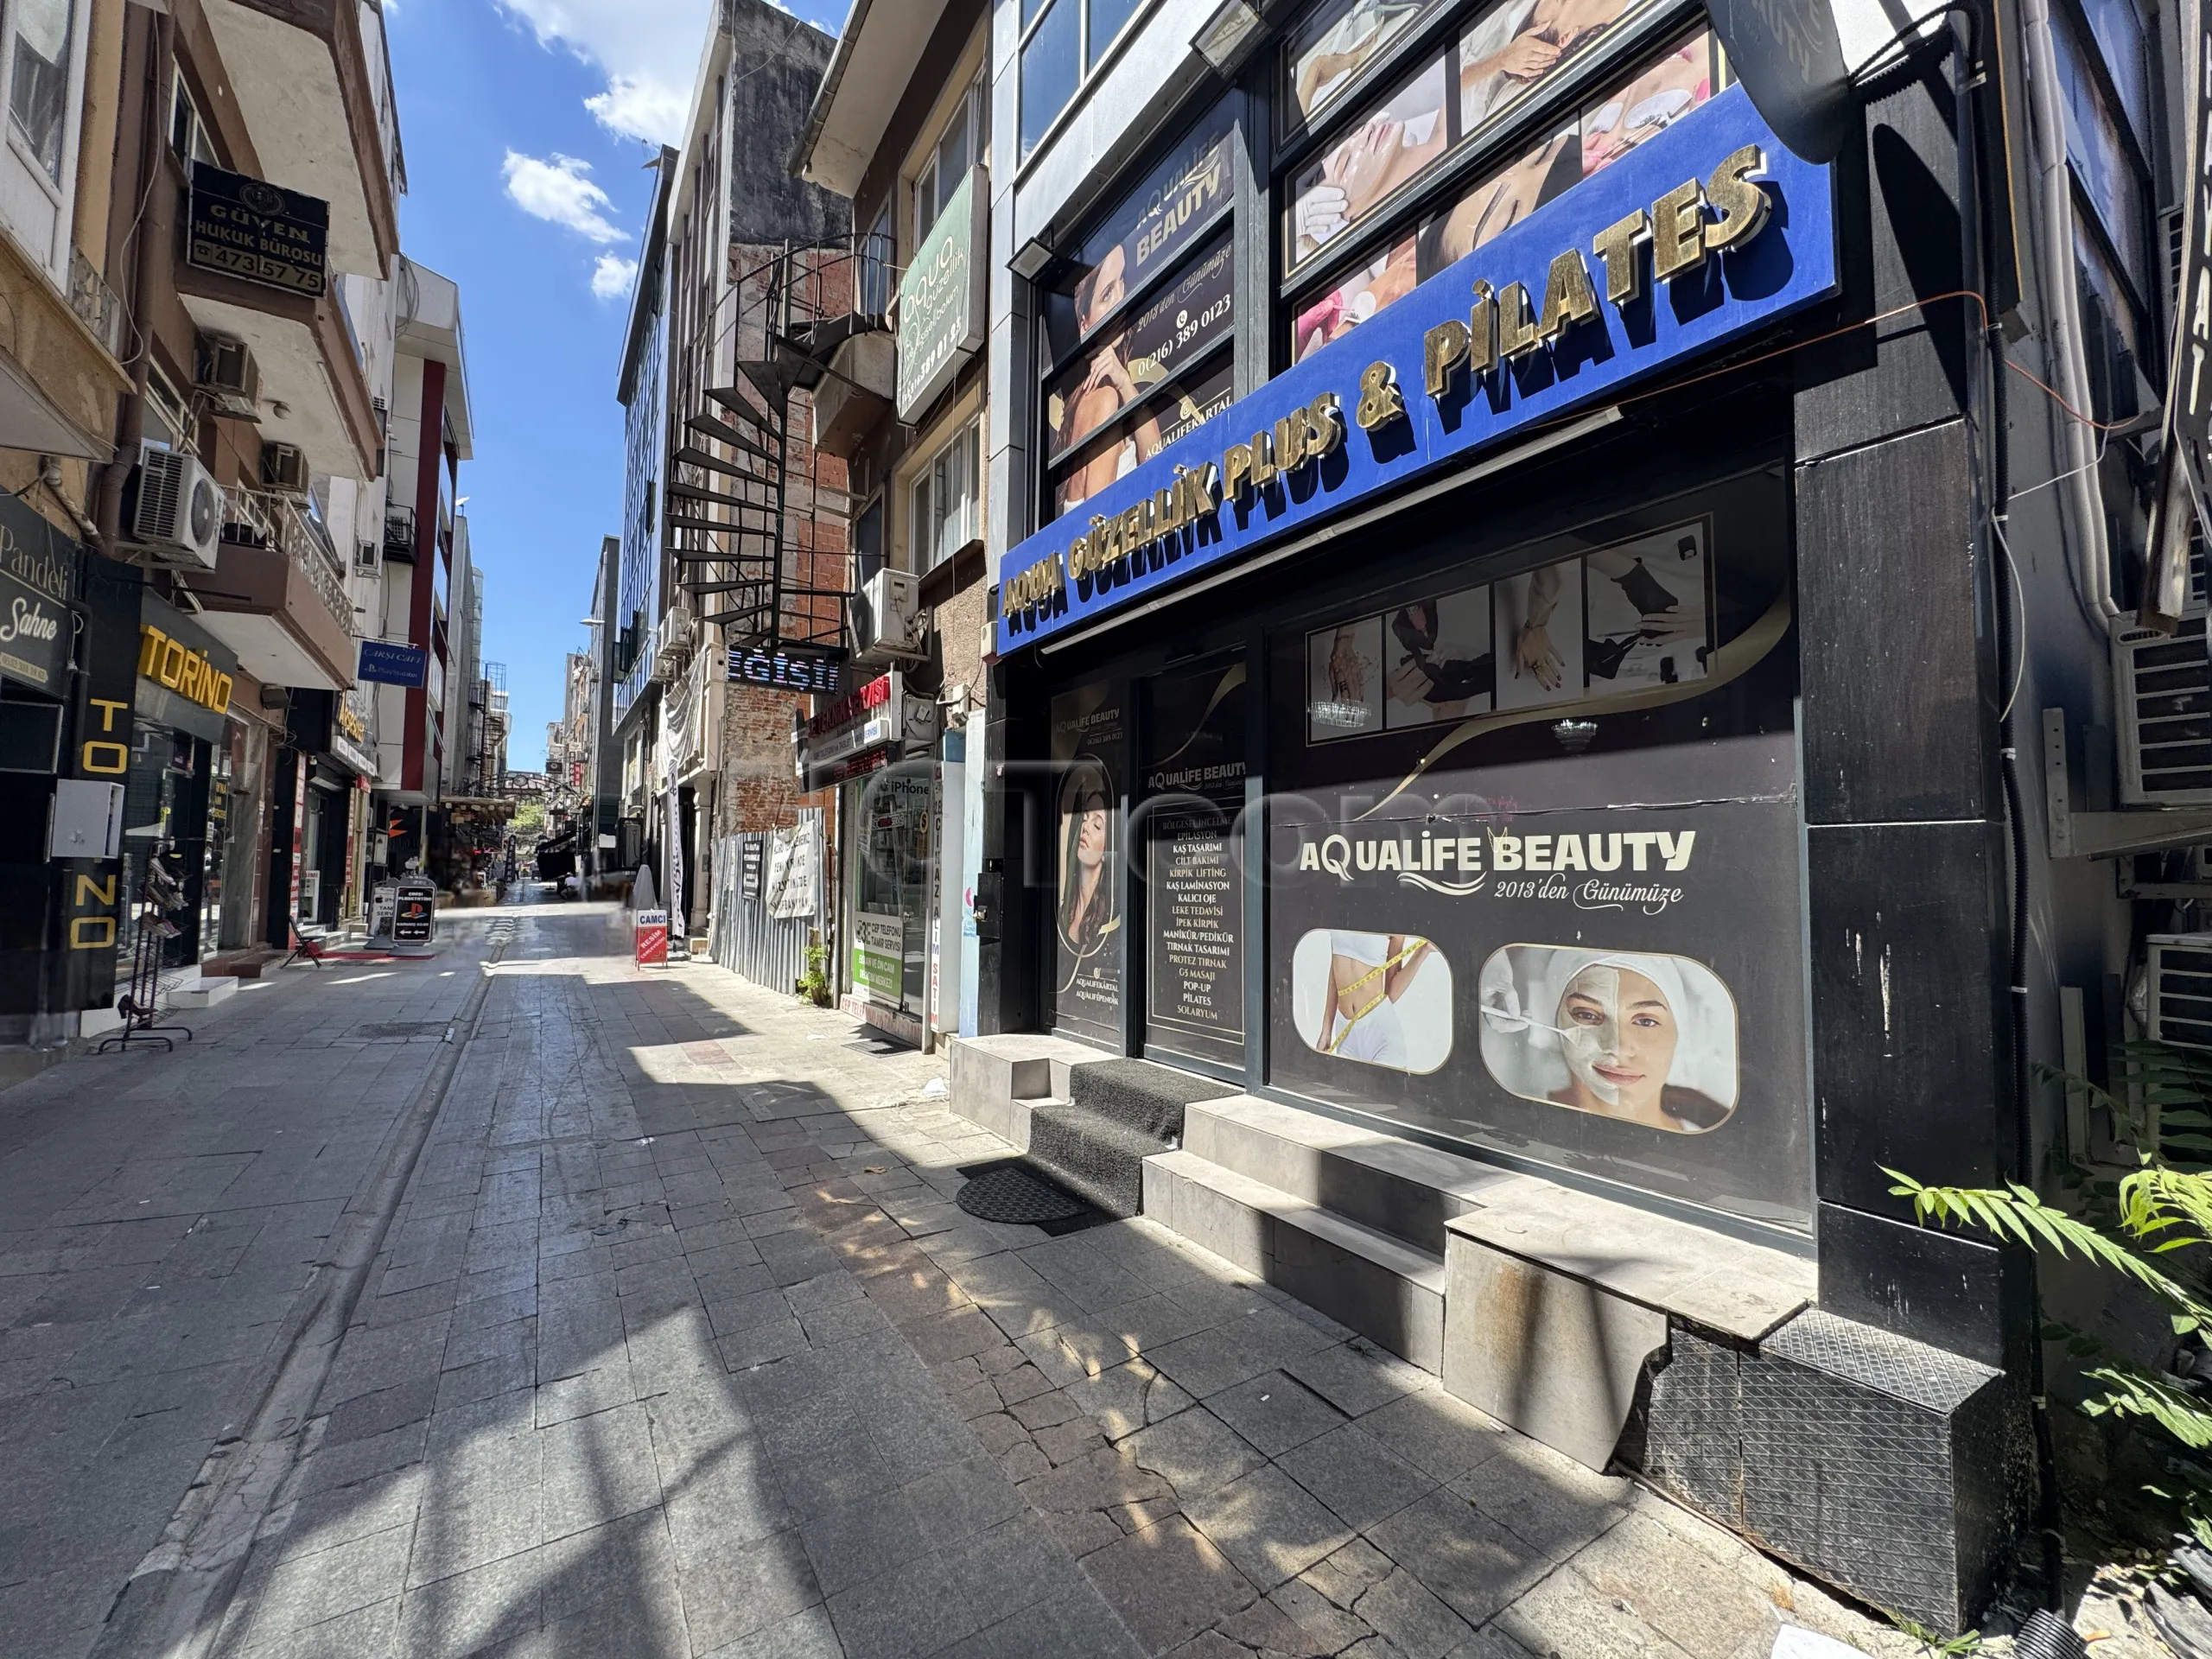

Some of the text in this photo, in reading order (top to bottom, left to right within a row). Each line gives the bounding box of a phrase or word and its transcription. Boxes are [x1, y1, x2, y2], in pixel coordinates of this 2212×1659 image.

[1136, 162, 1221, 267] BEAUTY
[210, 204, 311, 244] GÜVEN
[195, 219, 323, 267] HUKUK BÜROSU
[216, 250, 320, 289] 473 57 75
[904, 236, 953, 324] aqua
[927, 248, 964, 315] güzellik
[1138, 293, 1232, 378] 0(216) 389 0123
[1001, 143, 1772, 619] AQUA GÜZELLİK PLUS & PİLATES
[1145, 395, 1234, 461] AQUALIFEKARTAL
[0, 524, 67, 601] Pandeli
[0, 596, 58, 642] Sahne
[139, 624, 232, 715] TORİNO
[1090, 708, 1121, 724] BEAUTY
[1147, 766, 1202, 791] AQUALİFE
[891, 780, 929, 795] iPhone
[69, 698, 129, 950] TONO
[1177, 830, 1217, 841] EPİLASYON
[1173, 842, 1223, 855] KAŞ TASARIMI
[1300, 827, 1696, 882] AQUALİFE BEAUTY
[1175, 855, 1219, 866] CİLT BAKIMI
[1169, 866, 1227, 879] KİRPİK LİFTİNG
[1166, 880, 1230, 893] KAŞ LAMİNASYON
[1494, 872, 1683, 915] 2013'den Günümüze
[1178, 893, 1217, 905] KALICI OJE
[1172, 905, 1224, 917] LEKE TEDAVİSİ
[639, 914, 666, 925] CAMCI
[1176, 916, 1219, 929] İPEK KİRPİK
[880, 924, 902, 938] TELEFONU
[1163, 929, 1234, 944] MANİKÜR/PEDİKÜR
[640, 930, 663, 949] RESİM
[871, 934, 901, 952] TAMİR SERVİSİ
[1166, 941, 1230, 957] TIRNAK TASARIMI
[883, 961, 895, 975] CAM
[1169, 954, 1227, 969] PROTEZ TIRNAK
[1179, 968, 1216, 982] G5 MASAJI
[930, 963, 940, 1024] SATIM
[1183, 981, 1211, 993] POP-UP
[1183, 992, 1212, 1006] PİLATES
[1177, 1004, 1218, 1020] SOLARYUM
